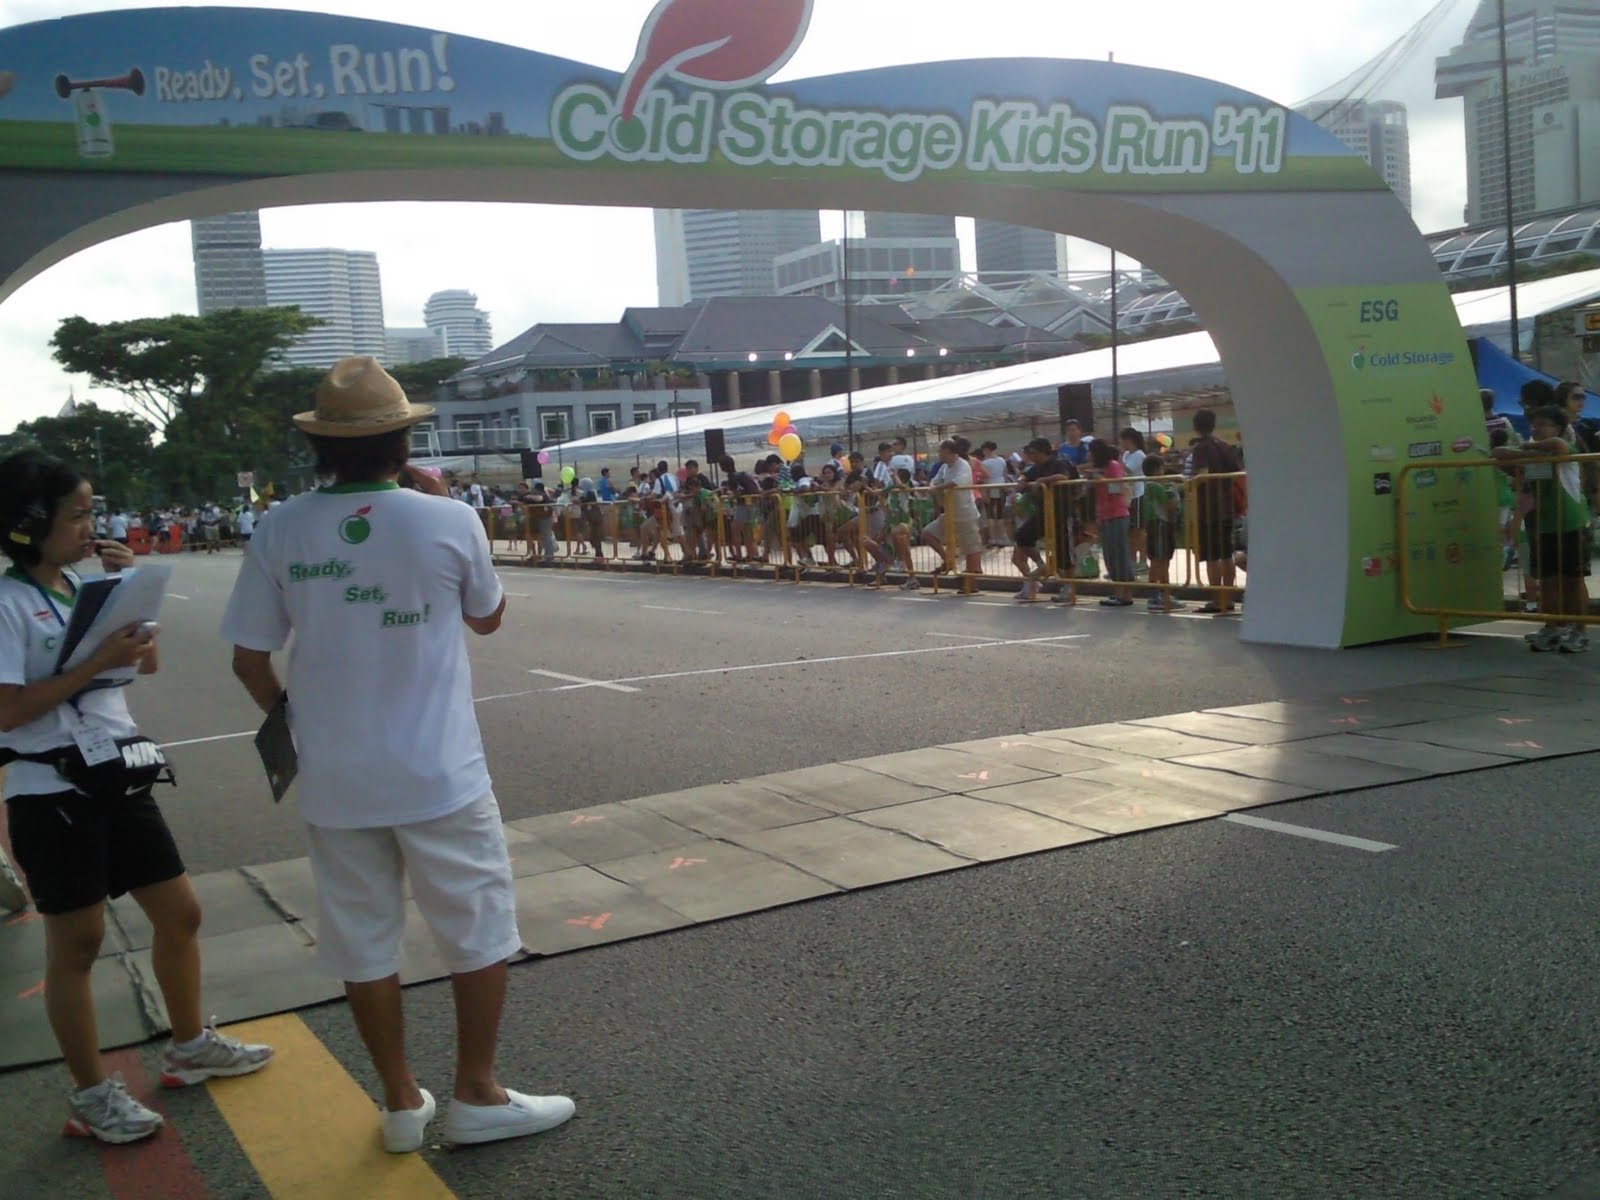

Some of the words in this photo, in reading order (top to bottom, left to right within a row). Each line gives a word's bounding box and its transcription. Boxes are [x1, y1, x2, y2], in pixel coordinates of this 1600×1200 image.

[153, 60, 244, 101] Ready,
[250, 51, 325, 99] Set,
[330, 33, 455, 96] Run!
[554, 88, 709, 158] Cold
[718, 96, 959, 177] Storage
[969, 104, 1094, 169] Kids
[1105, 110, 1206, 170] Run
[1359, 299, 1400, 323] ESG
[1369, 352, 1399, 368] Cold
[381, 602, 431, 627] Run!
